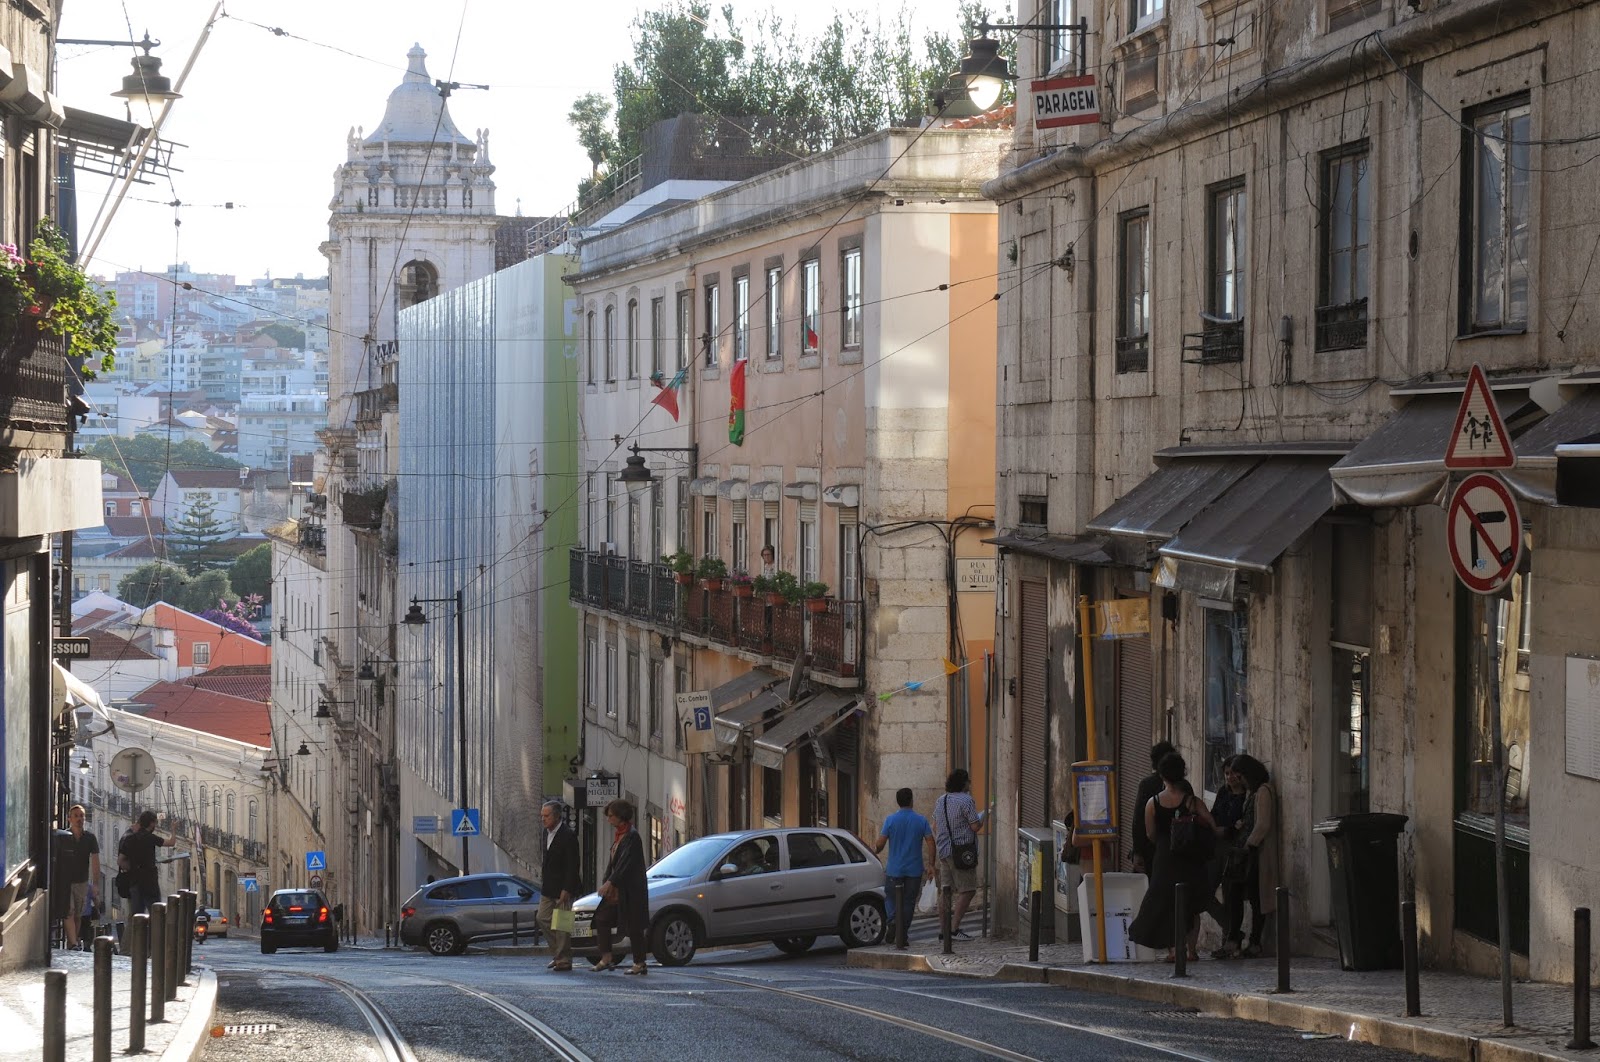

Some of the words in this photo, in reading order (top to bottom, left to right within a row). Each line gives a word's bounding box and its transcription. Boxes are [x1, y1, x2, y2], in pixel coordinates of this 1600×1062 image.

[1036, 89, 1095, 115] PARAGEM
[970, 561, 986, 569] RUA
[697, 712, 707, 729] P
